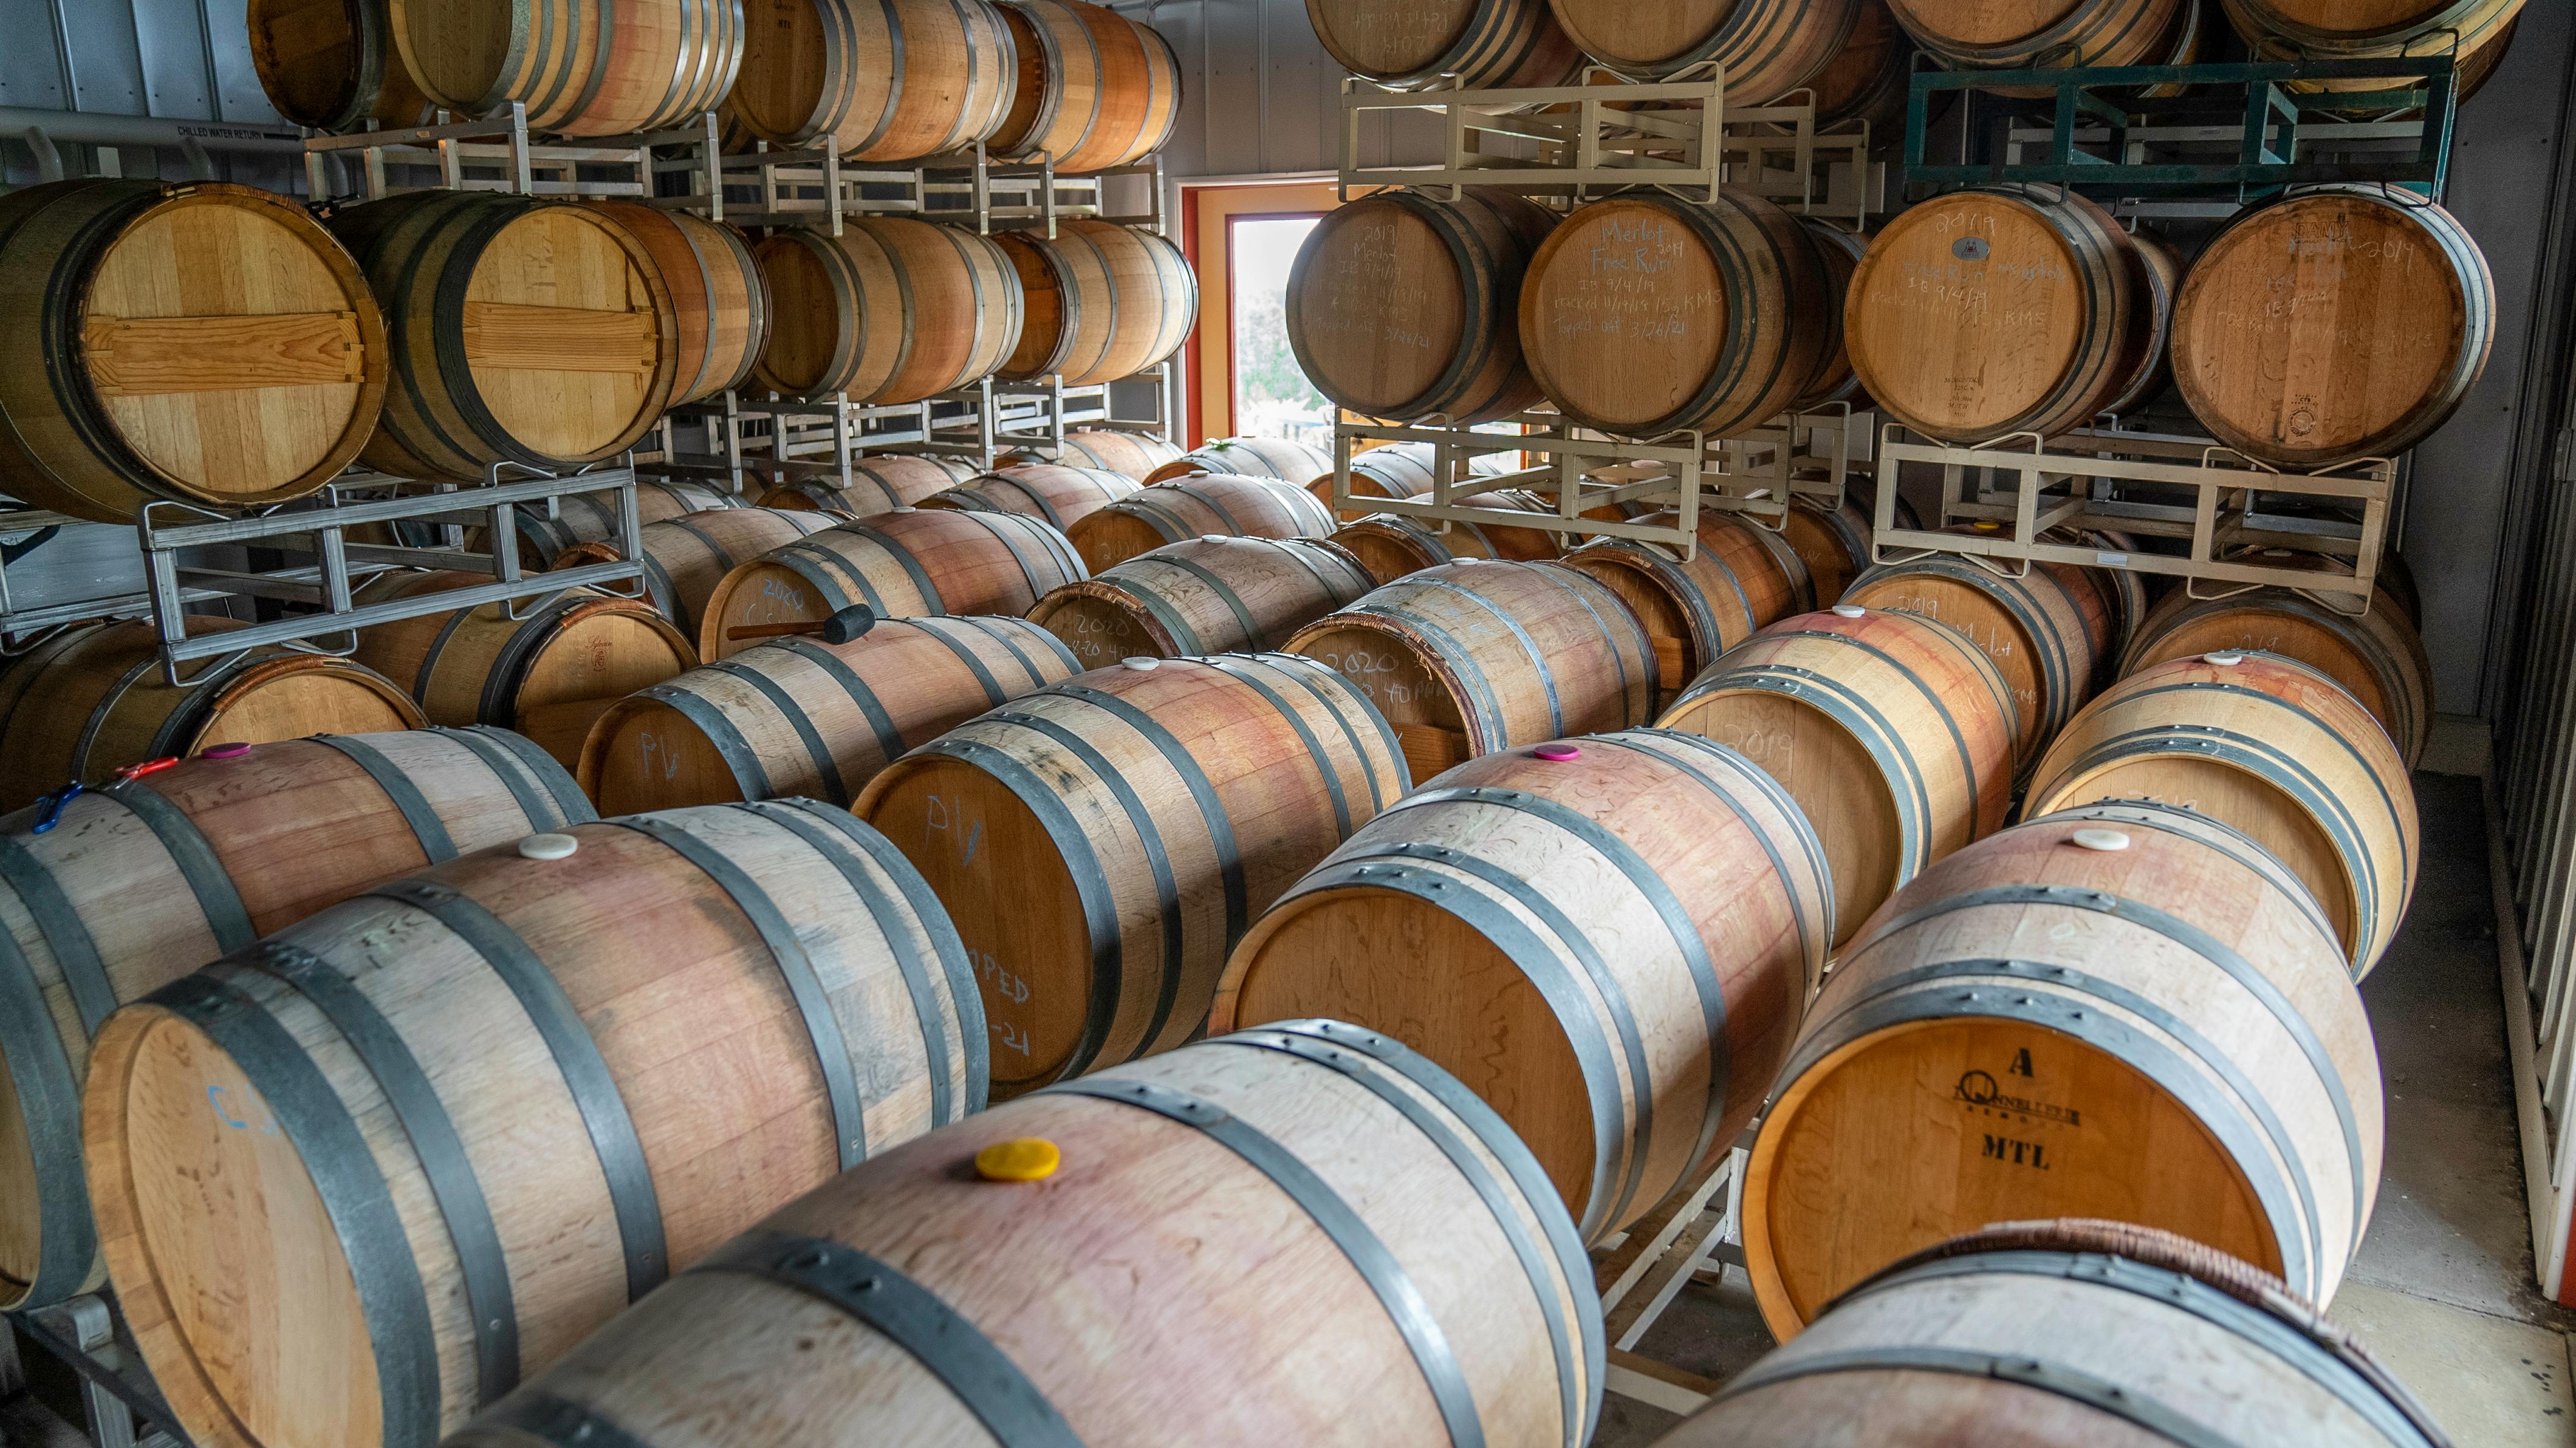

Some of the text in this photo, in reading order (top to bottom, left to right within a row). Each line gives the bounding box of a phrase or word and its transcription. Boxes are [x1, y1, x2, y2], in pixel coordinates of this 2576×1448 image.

[177, 126, 262, 141] CHILLED WATER RETURN
[1364, 224, 1396, 245] 2019
[1601, 219, 1669, 244] Merlot
[1936, 213, 1996, 237] 2019
[2295, 221, 2349, 239] DAMY
[1354, 242, 1398, 263] Merlot
[1590, 247, 1630, 276] Free
[2358, 239, 2414, 277] 2019
[1606, 273, 1654, 294] 9/4/19
[1075, 613, 1131, 637] 2020
[1326, 651, 1400, 674] 2020
[2009, 1048, 2033, 1077] A
[1982, 1134, 2050, 1170] MTL
